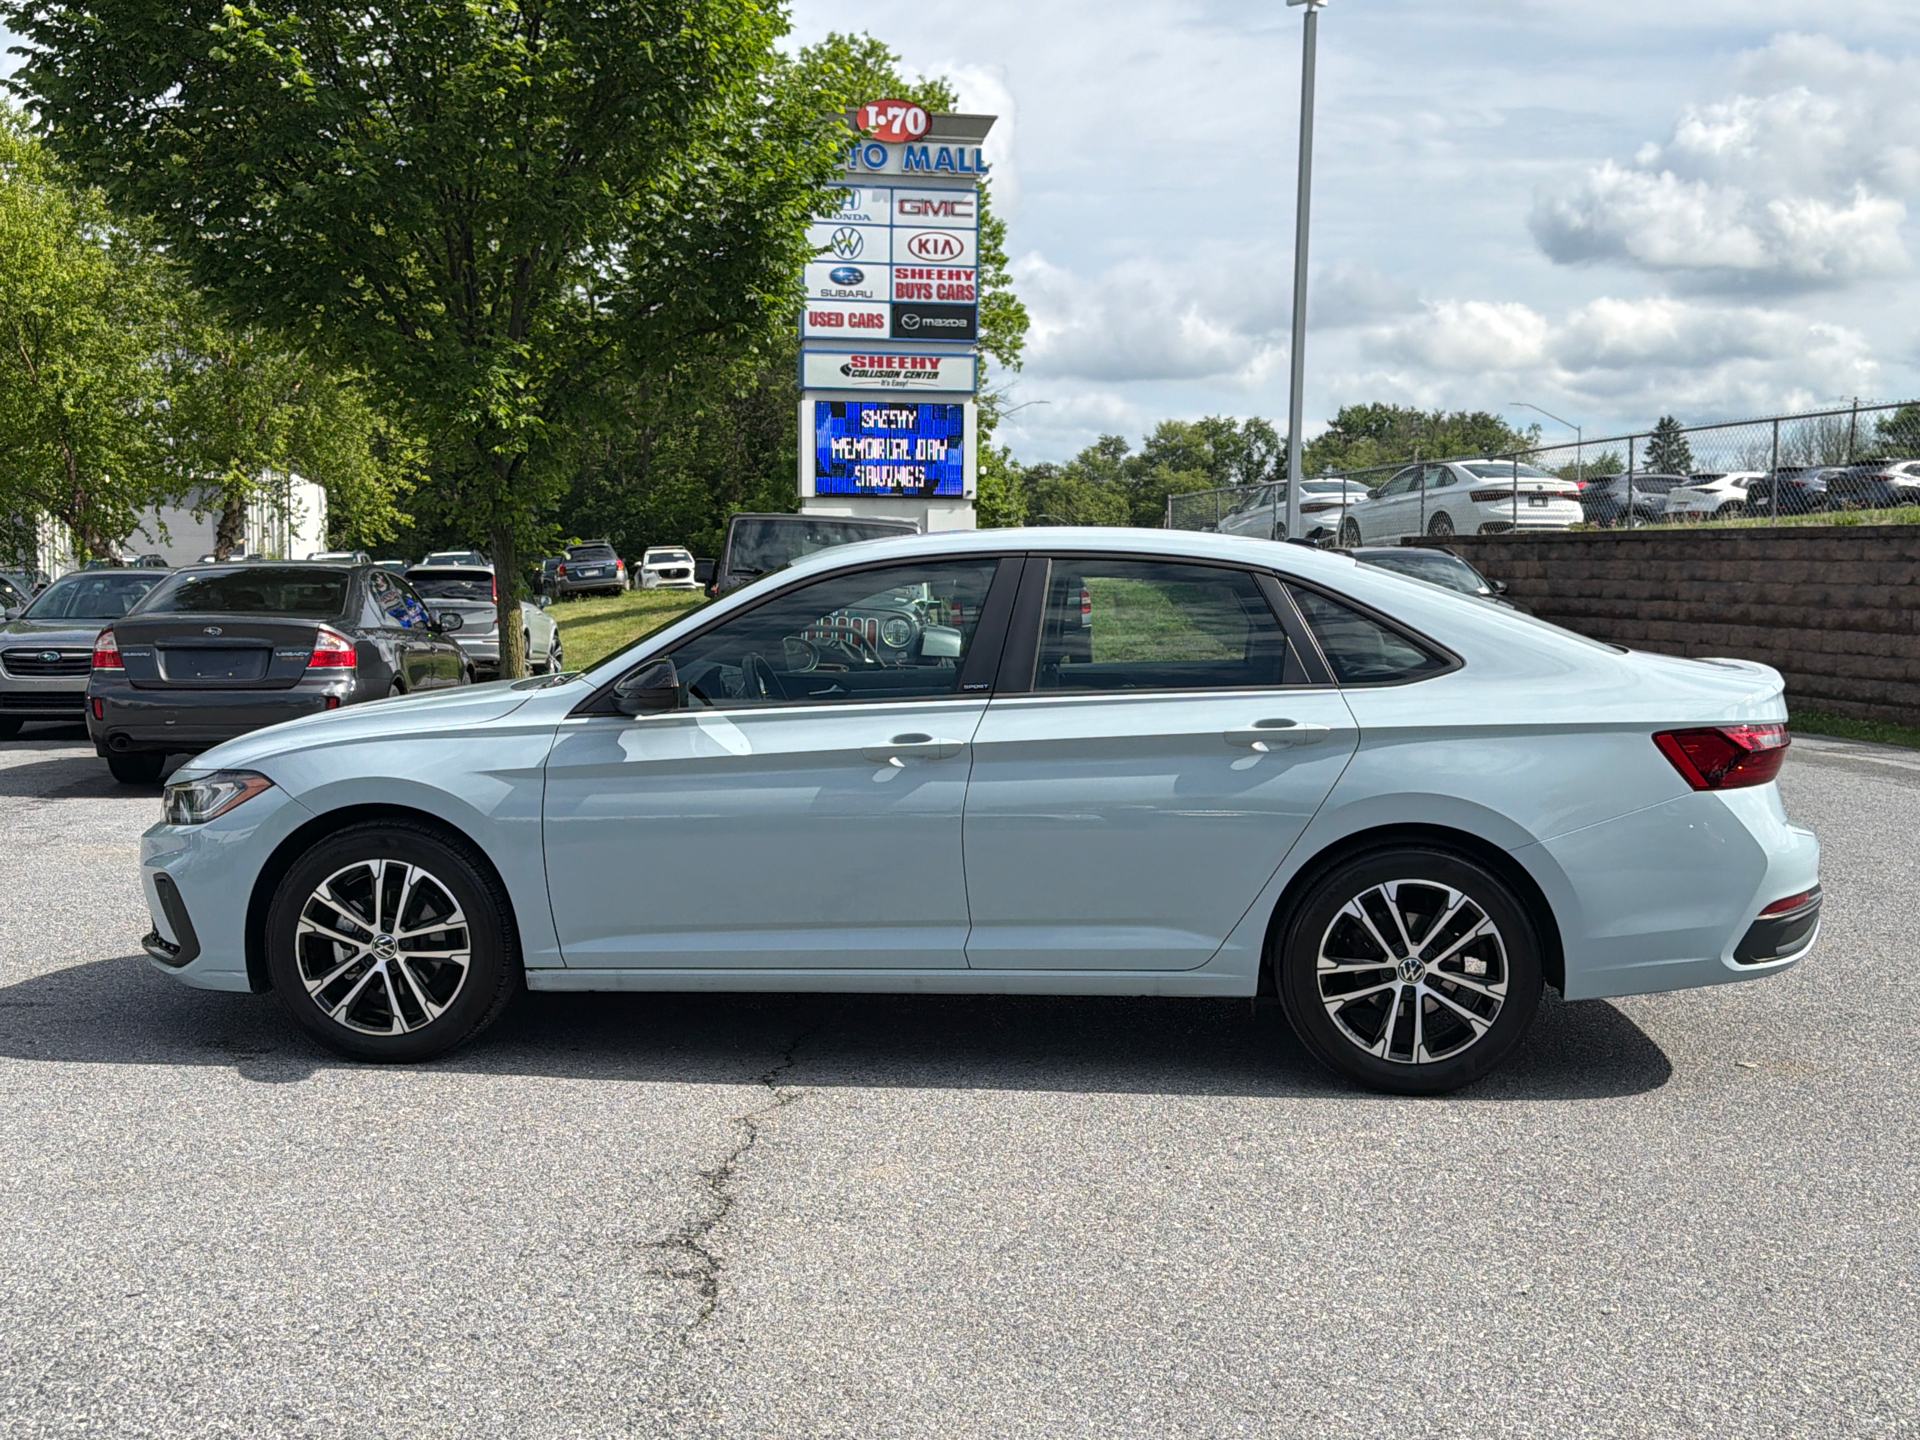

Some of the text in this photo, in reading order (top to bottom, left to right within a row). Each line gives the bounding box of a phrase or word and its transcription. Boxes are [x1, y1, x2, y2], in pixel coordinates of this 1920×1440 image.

[903, 144, 989, 174] MALL
[826, 213, 872, 221] ONDA
[899, 198, 974, 219] GMC
[917, 238, 955, 256] KIA
[894, 267, 976, 282] SHEEHY
[820, 288, 874, 299] SUBARU
[894, 281, 975, 302] BUYS CARS
[808, 311, 885, 330] USED CARS
[850, 355, 942, 370] SHEEHY
[851, 369, 940, 380] COLLISION CENTER
[861, 409, 918, 429] SHEEHY
[915, 438, 948, 461] DAY
